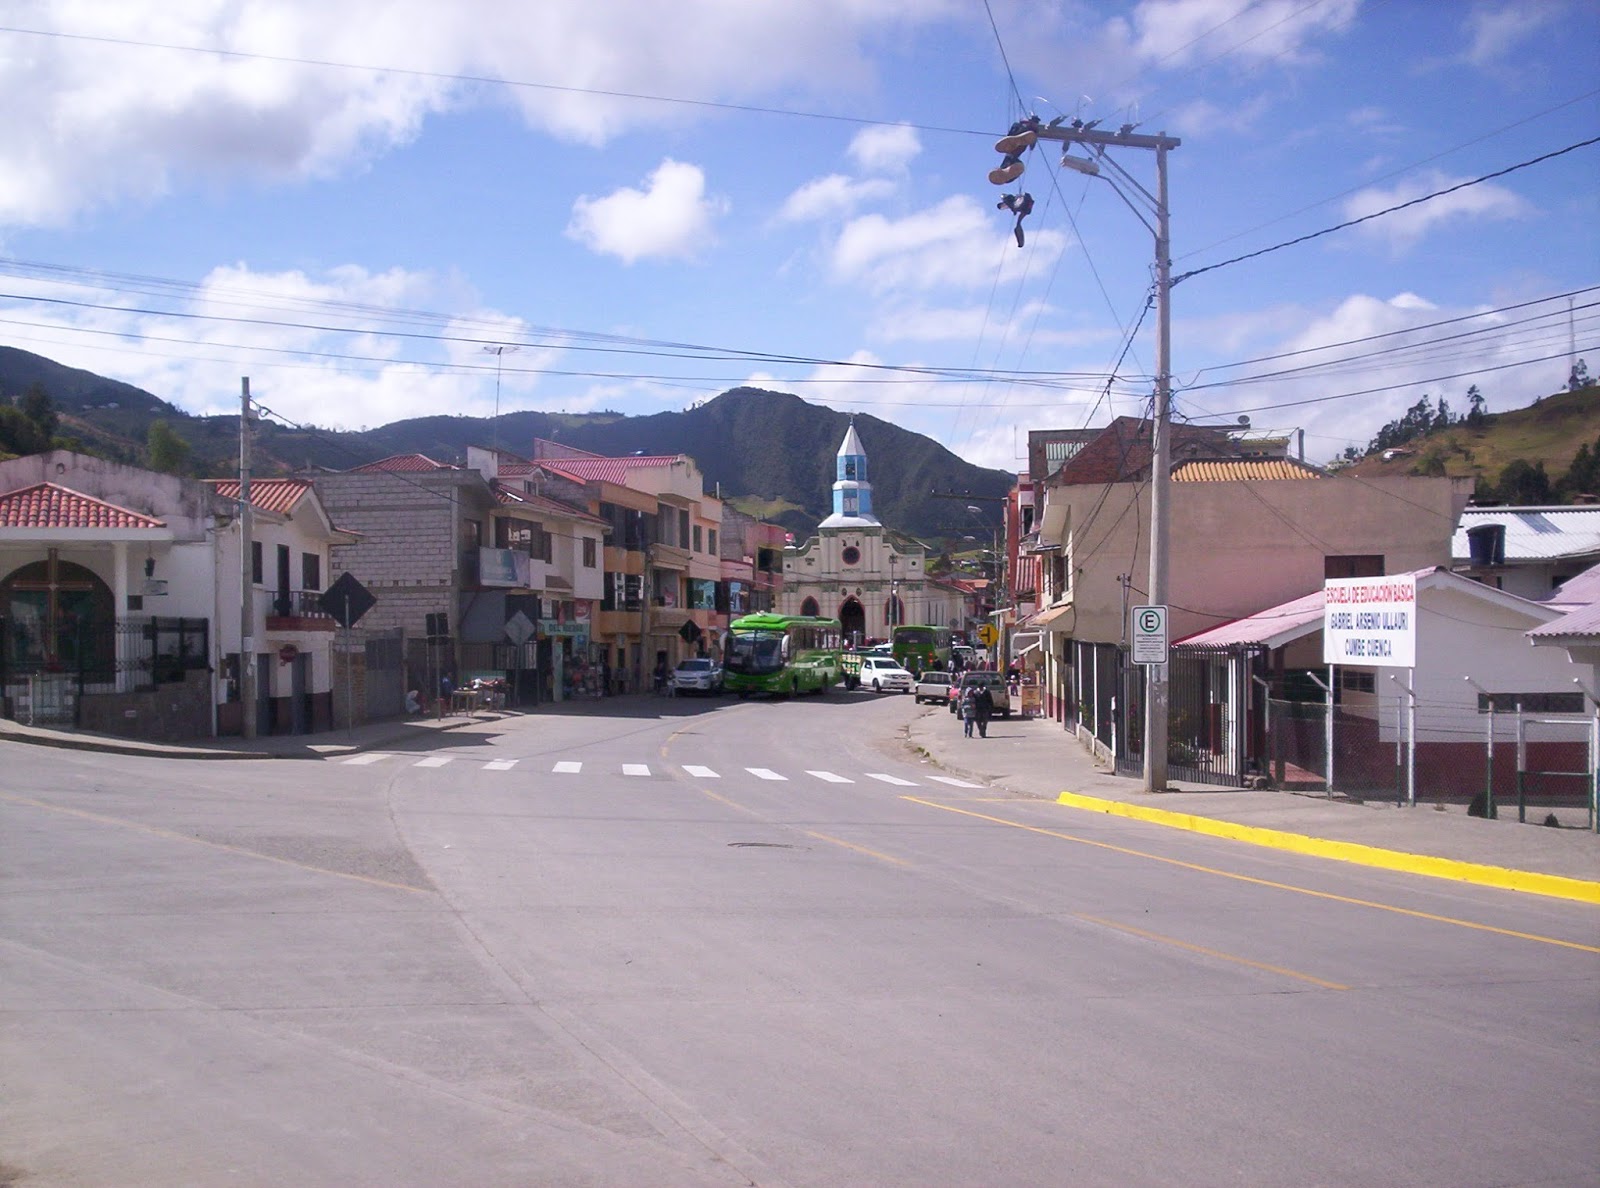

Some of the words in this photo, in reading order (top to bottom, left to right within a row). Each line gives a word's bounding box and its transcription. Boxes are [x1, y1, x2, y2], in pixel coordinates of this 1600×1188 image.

[1326, 586, 1350, 604] ESCUELA
[1352, 586, 1360, 604] DE
[1145, 614, 1155, 628] E
[1330, 612, 1353, 630] GABRIEL
[1356, 612, 1381, 630] ARSENIO
[1382, 612, 1408, 630] ULLAURI
[1345, 638, 1365, 657] CUMBE
[1367, 638, 1392, 657] CUENCA
